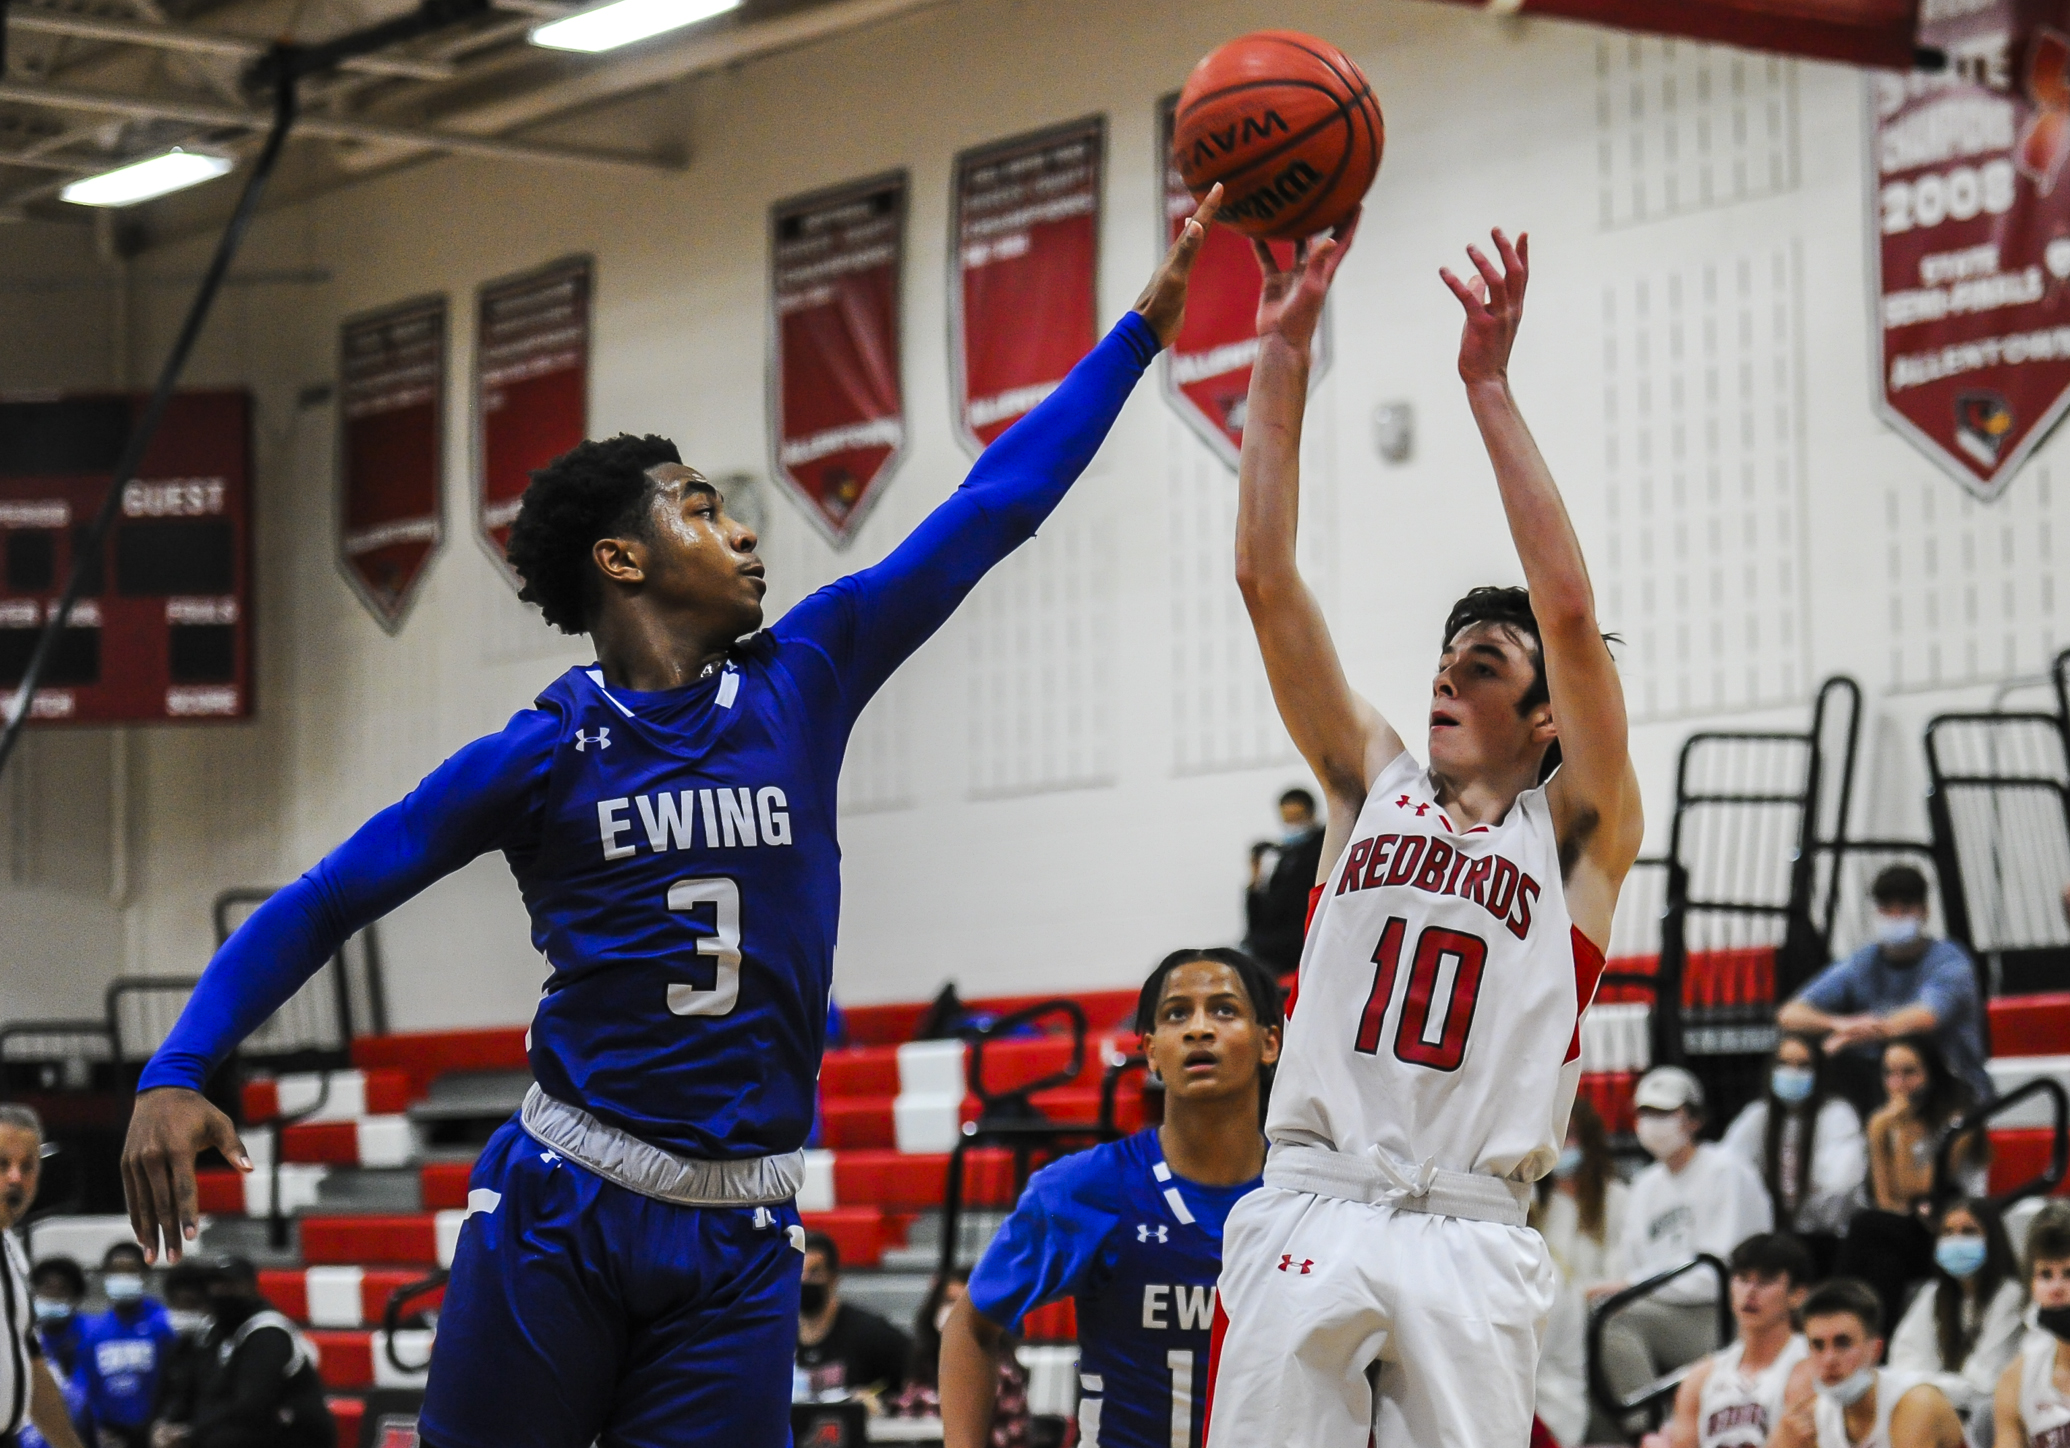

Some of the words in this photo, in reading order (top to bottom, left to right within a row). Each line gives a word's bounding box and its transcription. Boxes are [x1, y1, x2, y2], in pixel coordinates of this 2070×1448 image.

[1881, 158, 2016, 234] 2008
[121, 477, 225, 519] GUEST
[597, 785, 792, 861] EWING
[1335, 833, 1541, 941] REDBIRDS
[666, 876, 742, 1017] 3
[1354, 915, 1489, 1073] 10
